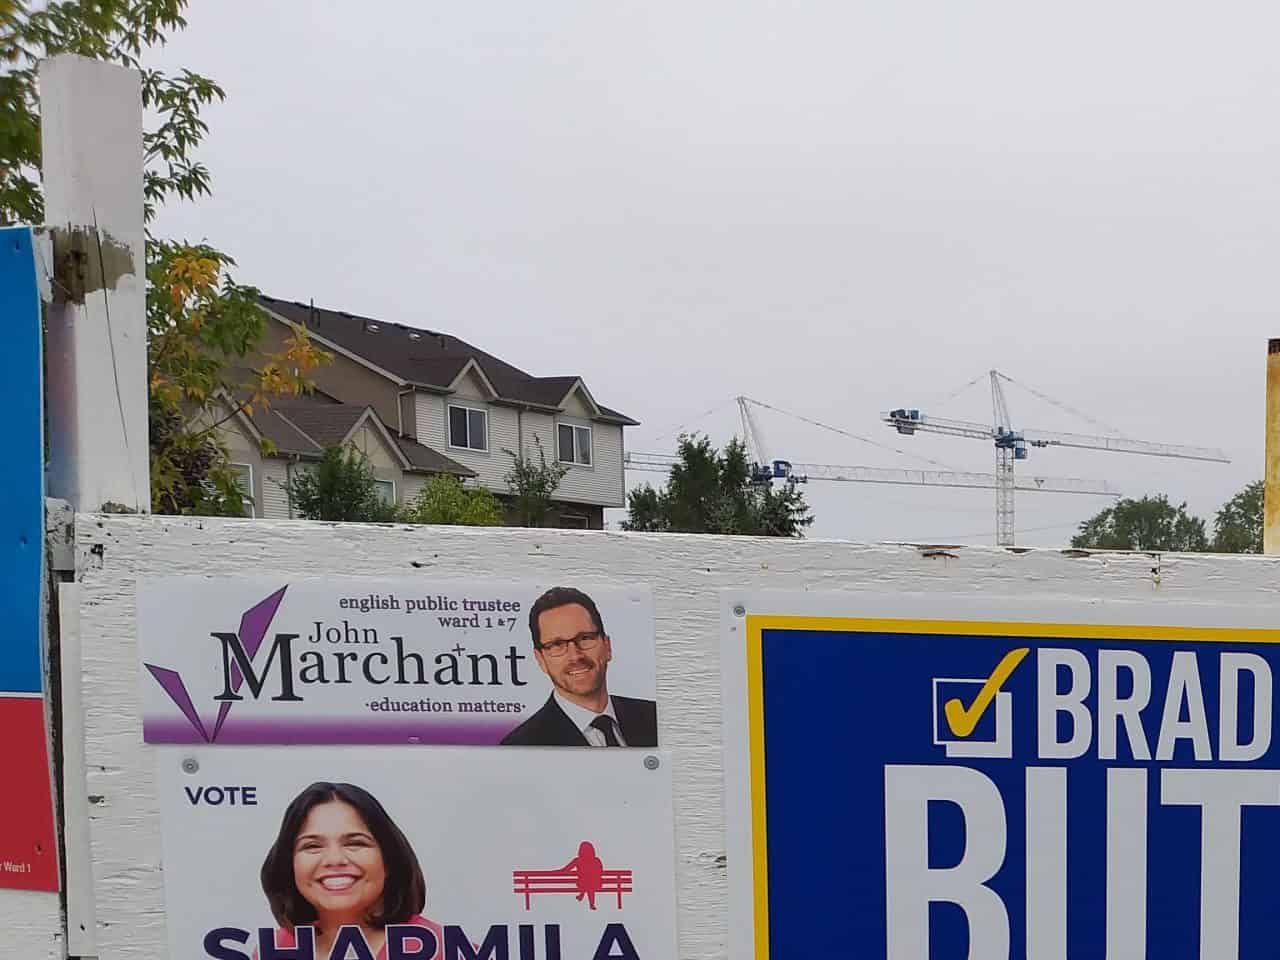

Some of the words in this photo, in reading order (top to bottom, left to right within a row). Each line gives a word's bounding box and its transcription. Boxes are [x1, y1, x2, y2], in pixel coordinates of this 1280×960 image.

[339, 595, 400, 613] english
[406, 596, 458, 613] public
[462, 598, 521, 612] trustee
[438, 614, 480, 628] ward
[485, 617, 493, 628] 1
[308, 621, 379, 644] John
[210, 632, 527, 702] Marchant
[1036, 648, 1275, 762] BRAD
[185, 786, 257, 806] VOTE
